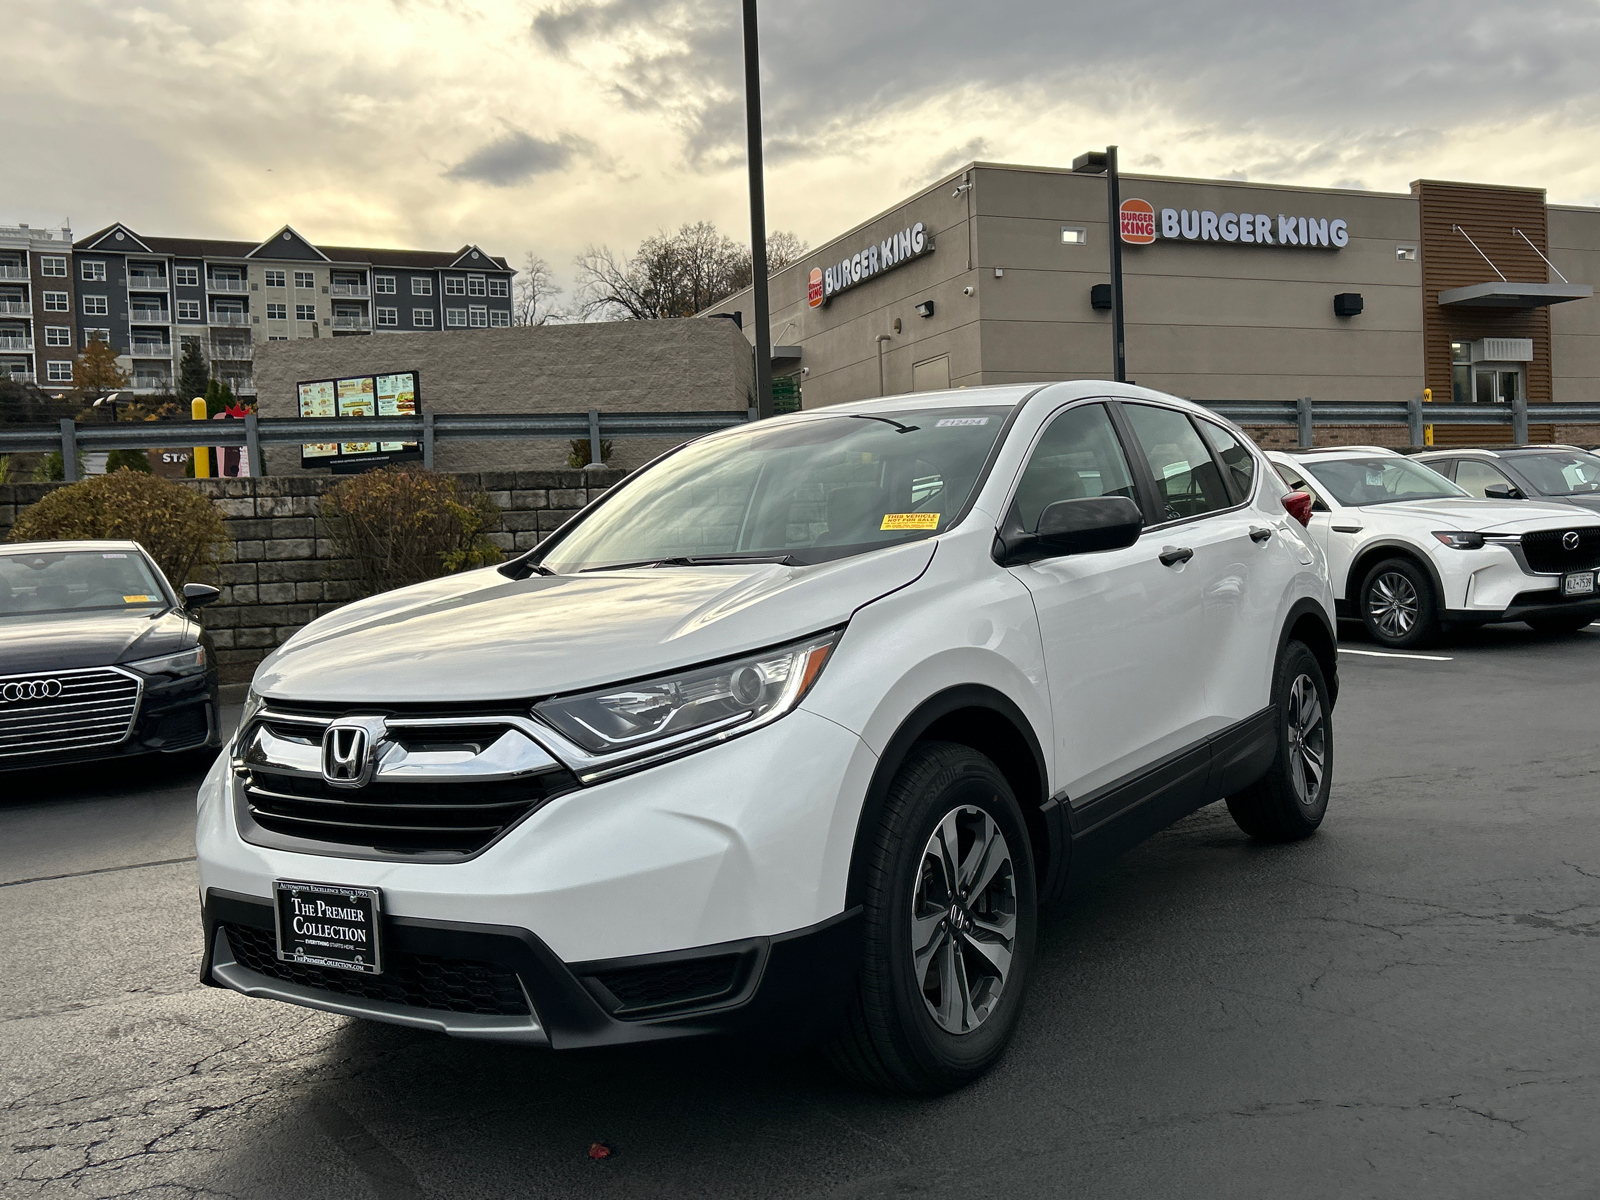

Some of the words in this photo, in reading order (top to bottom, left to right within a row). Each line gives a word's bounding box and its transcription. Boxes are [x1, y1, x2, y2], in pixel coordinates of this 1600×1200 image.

[1121, 212, 1154, 223] BURGER
[1121, 221, 1154, 235] KING
[1161, 208, 1273, 244] BURGER
[1278, 215, 1349, 247] KING
[825, 245, 879, 295] BURGER
[880, 222, 924, 269] KING
[808, 286, 823, 301] KING
[291, 897, 316, 917] THE
[316, 900, 365, 922] PREMIER
[293, 916, 367, 943] COLLECTION
